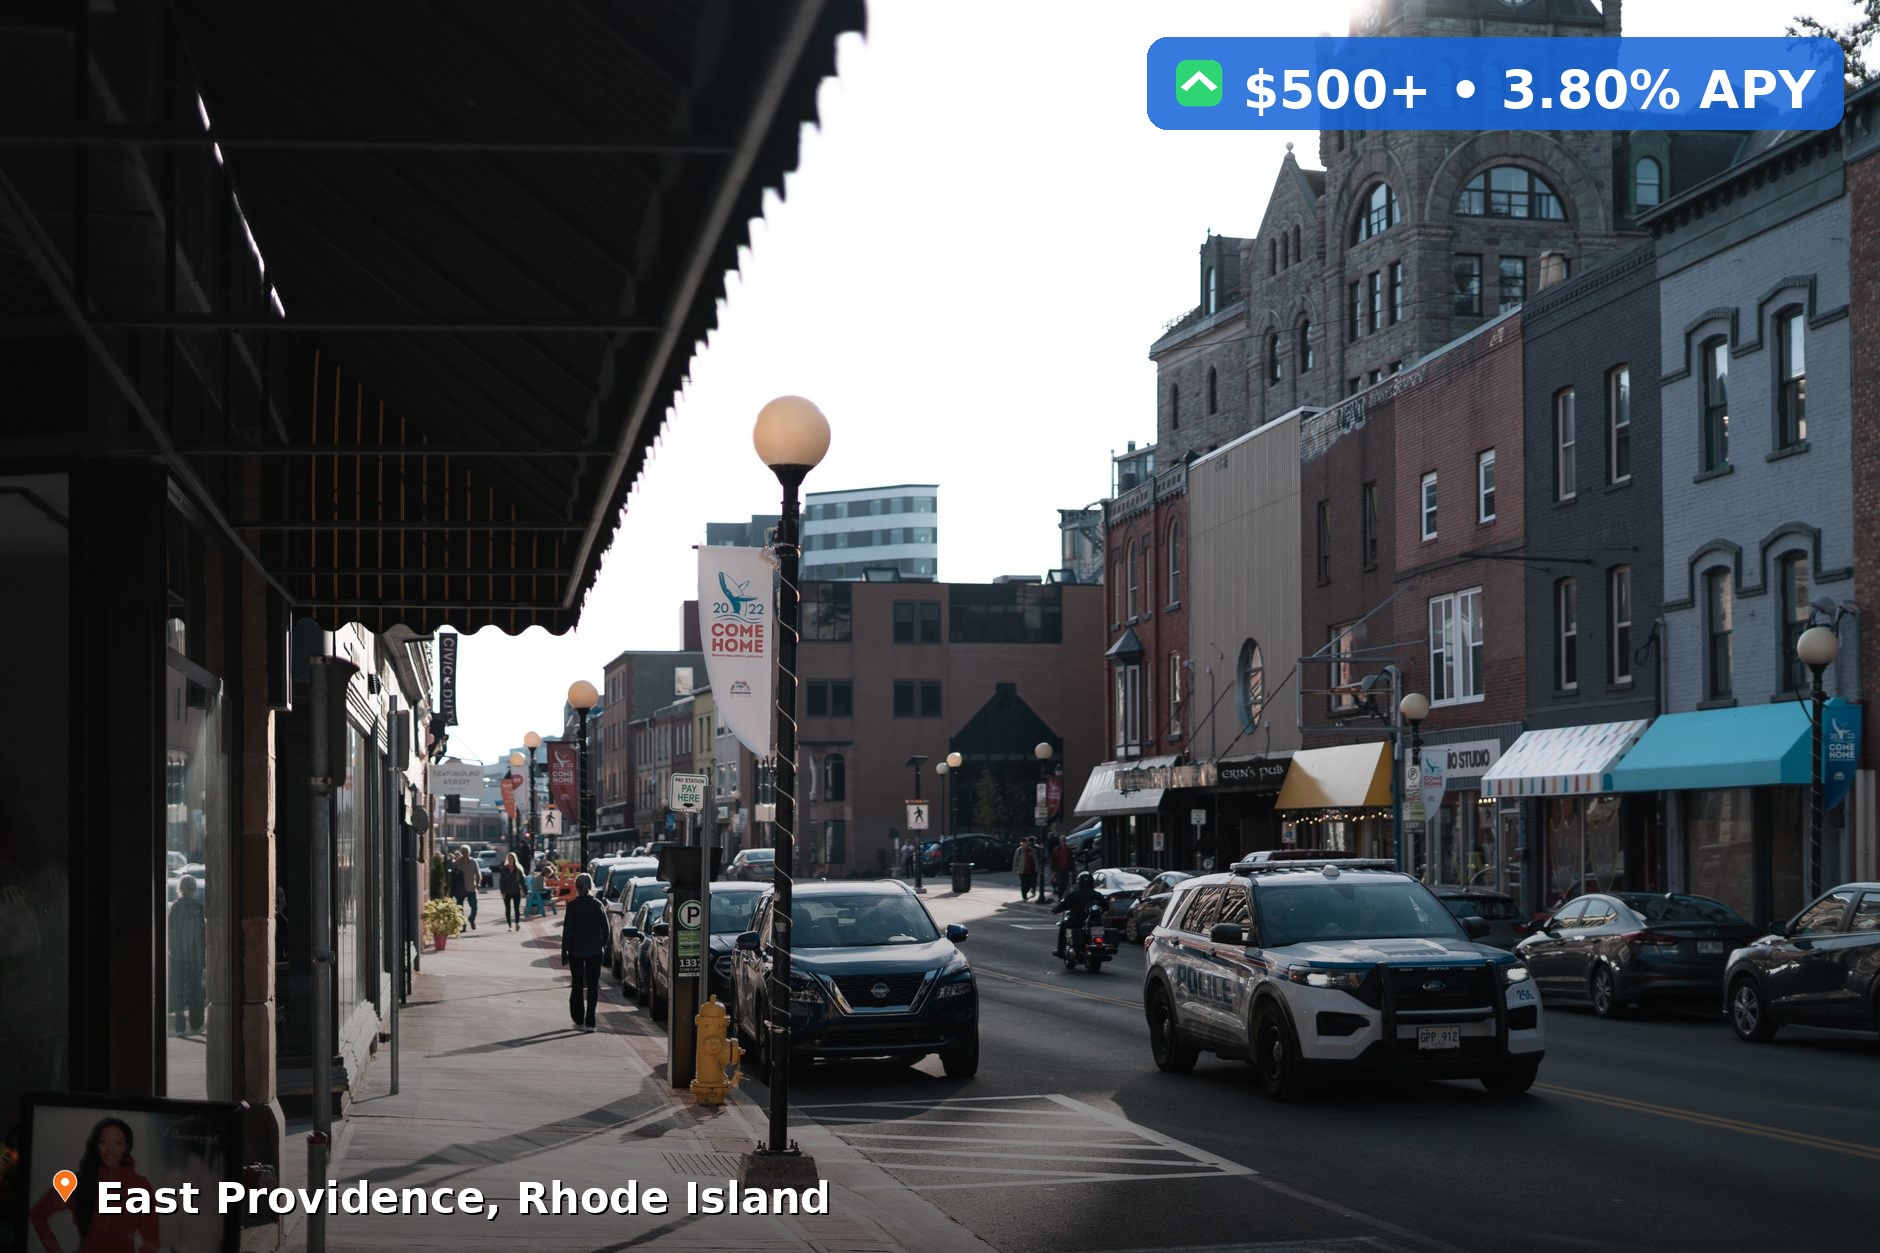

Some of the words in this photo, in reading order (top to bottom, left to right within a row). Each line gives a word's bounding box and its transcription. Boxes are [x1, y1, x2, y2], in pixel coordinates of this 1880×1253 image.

[713, 602, 729, 614] 20
[748, 603, 764, 615] 22
[711, 623, 764, 638] COME
[711, 638, 764, 653] HOME
[443, 638, 455, 676] CIVIC
[1458, 748, 1490, 768] STUDIO
[1829, 751, 1856, 759] HOME
[682, 784, 697, 793] PAY
[677, 793, 701, 803] HERE
[687, 906, 700, 924] P
[1176, 963, 1234, 1005] POLICE
[1420, 1031, 1437, 1043] GPP
[1441, 1031, 1458, 1042] 912
